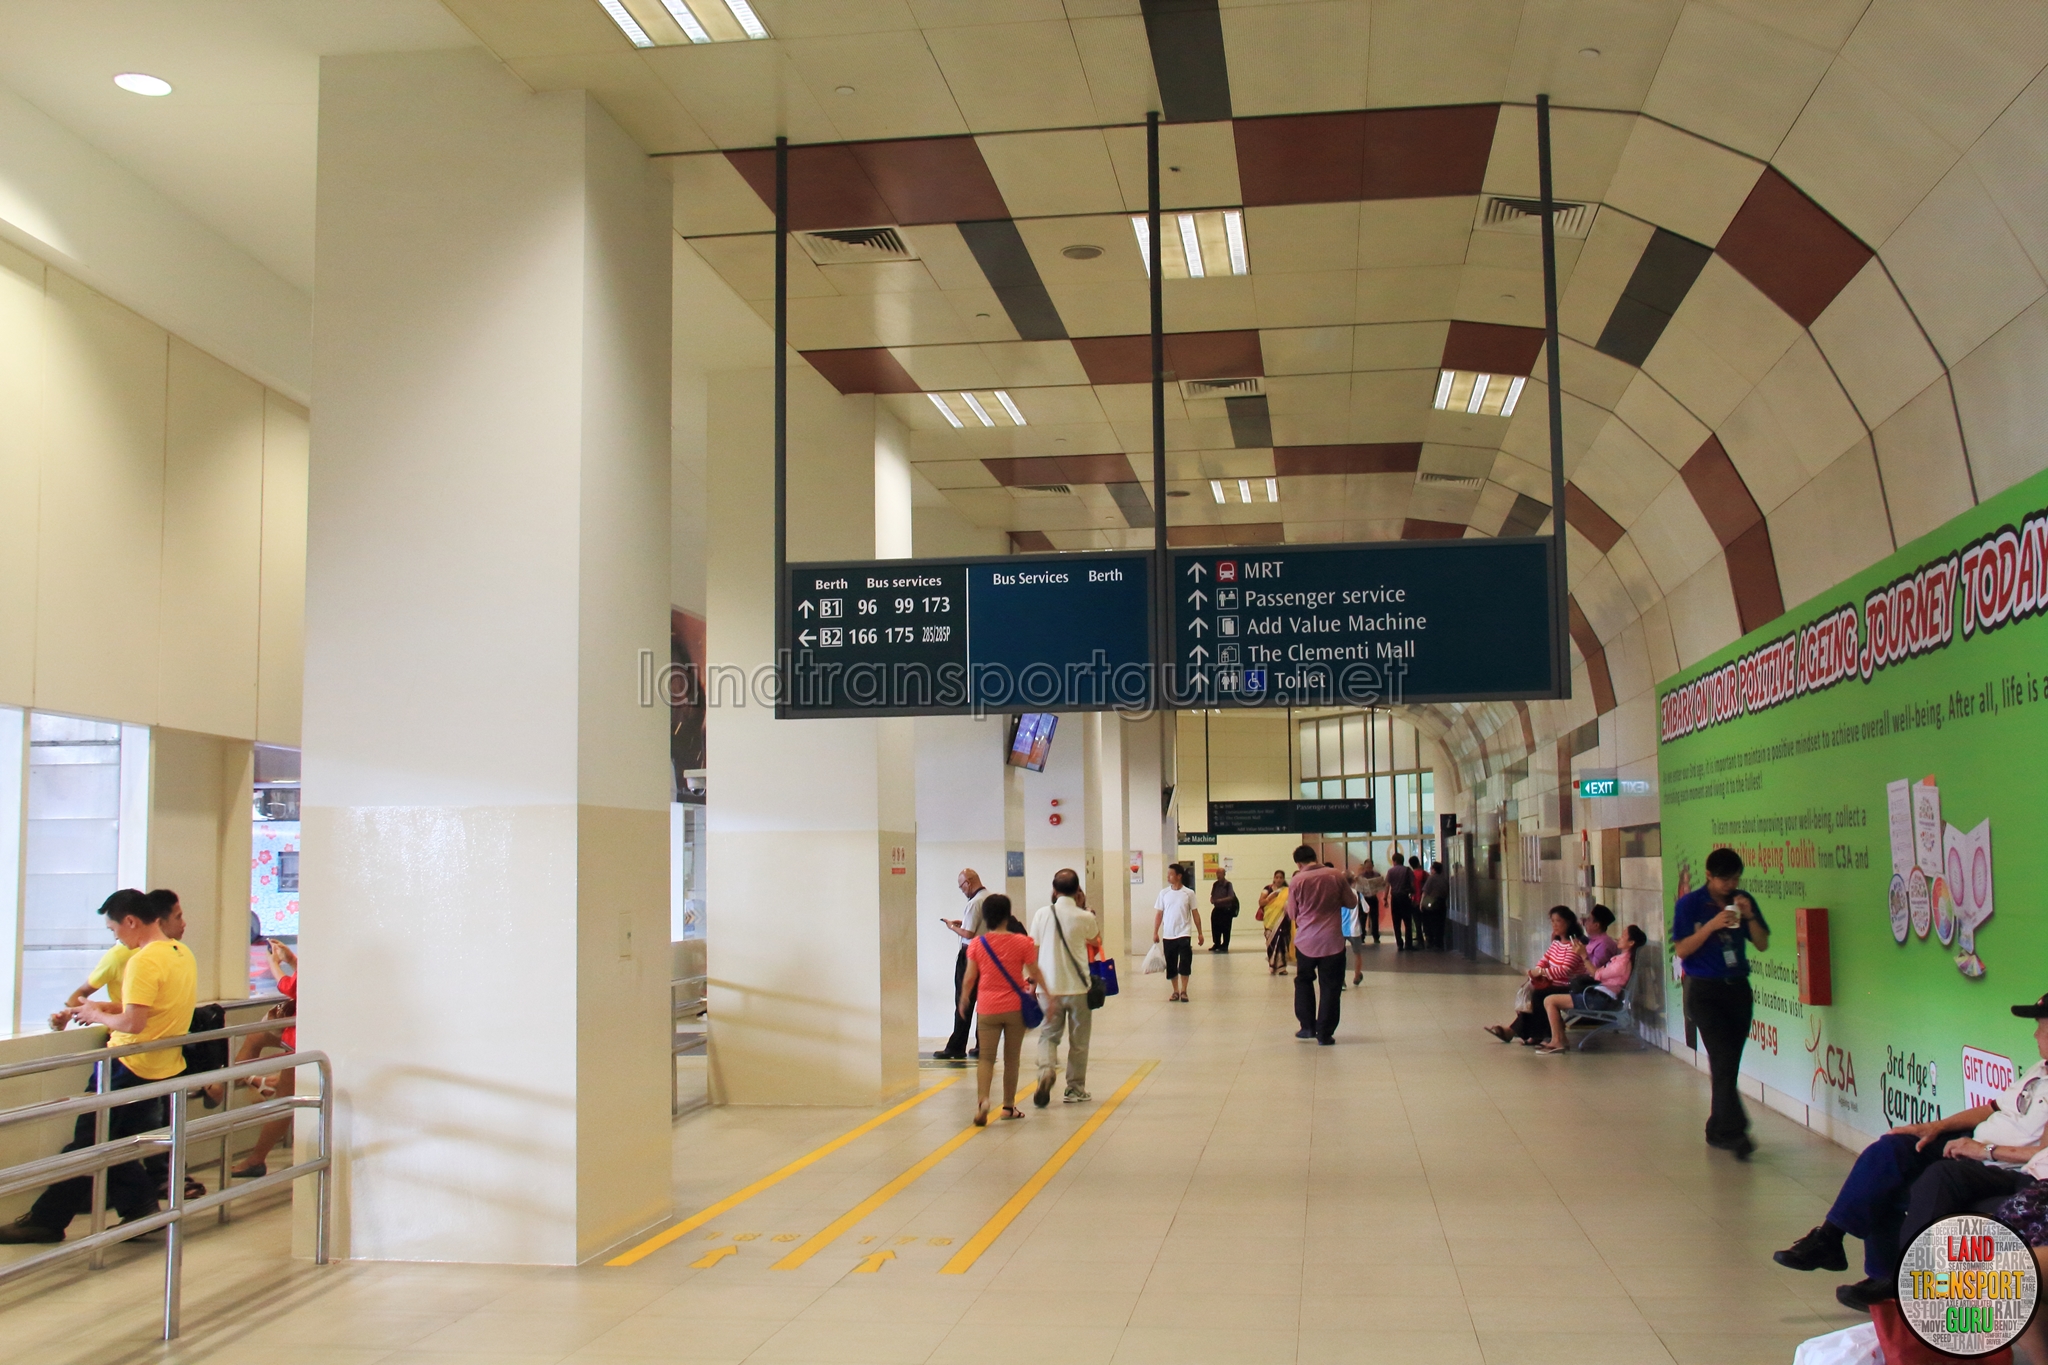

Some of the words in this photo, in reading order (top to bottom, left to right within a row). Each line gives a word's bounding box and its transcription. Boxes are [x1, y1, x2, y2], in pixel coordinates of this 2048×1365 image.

[815, 578, 848, 590] Berth
[866, 577, 889, 589] Bus
[892, 575, 942, 588] services
[993, 573, 1016, 586] Bus
[1019, 571, 1069, 585] Services
[1089, 569, 1123, 583] Berth
[1244, 561, 1283, 579] MRT
[821, 601, 841, 616] B1
[858, 600, 878, 616] 96
[894, 598, 914, 614] 99
[922, 597, 950, 613] 173
[1245, 589, 1335, 610] Passenger
[1343, 585, 1406, 604] service
[821, 629, 841, 645] B2
[849, 629, 878, 645] 166
[885, 627, 914, 643] 175
[1247, 617, 1282, 636] Add
[1289, 615, 1341, 634] Value
[1349, 613, 1427, 633] Machine
[1248, 645, 1282, 663] The
[1287, 642, 1369, 662] Clementi
[1376, 640, 1415, 659] Mall
[1661, 682, 1695, 743] EMBARK
[1695, 677, 1708, 729] ON
[1708, 664, 1738, 725] YOUR
[1738, 634, 1797, 713] POSITIVE
[1796, 607, 1858, 693] AGEING
[1860, 556, 1958, 679] JOURNEY
[1274, 671, 1326, 690] Toilet
[1772, 738, 1794, 764] positive
[1796, 733, 1820, 755] mindset
[1822, 730, 1829, 748] to
[1831, 721, 1859, 746] achieve
[1861, 709, 1889, 740] overall
[1893, 699, 1945, 730] well-being.
[1949, 690, 1974, 720] After
[1979, 682, 1998, 716] all,
[2002, 675, 2023, 708] life
[2027, 672, 2039, 702] is
[1591, 781, 1614, 794] EXIT
[1297, 803, 1326, 811] Passenger
[1757, 813, 1784, 836] improving
[1785, 815, 1798, 836] your
[1799, 807, 1834, 834] well-being,
[1836, 804, 1860, 828] collect
[1862, 810, 1867, 826] a
[1758, 842, 1784, 875] Ageing
[1785, 838, 1816, 868] Toolkit
[1818, 847, 1834, 869] from
[1835, 844, 1852, 869] C3A
[1855, 846, 1869, 869] and
[1765, 958, 1790, 984] collection
[1762, 987, 1788, 1014] locations
[1789, 996, 1803, 1018] visit
[1749, 1019, 1778, 1056] .org.sg
[1826, 1044, 1858, 1097] C3A
[1887, 1044, 1904, 1079] 3rd
[1907, 1052, 1928, 1096] Age
[1963, 1055, 1983, 1084] GIFT
[1986, 1061, 2012, 1091] CODE
